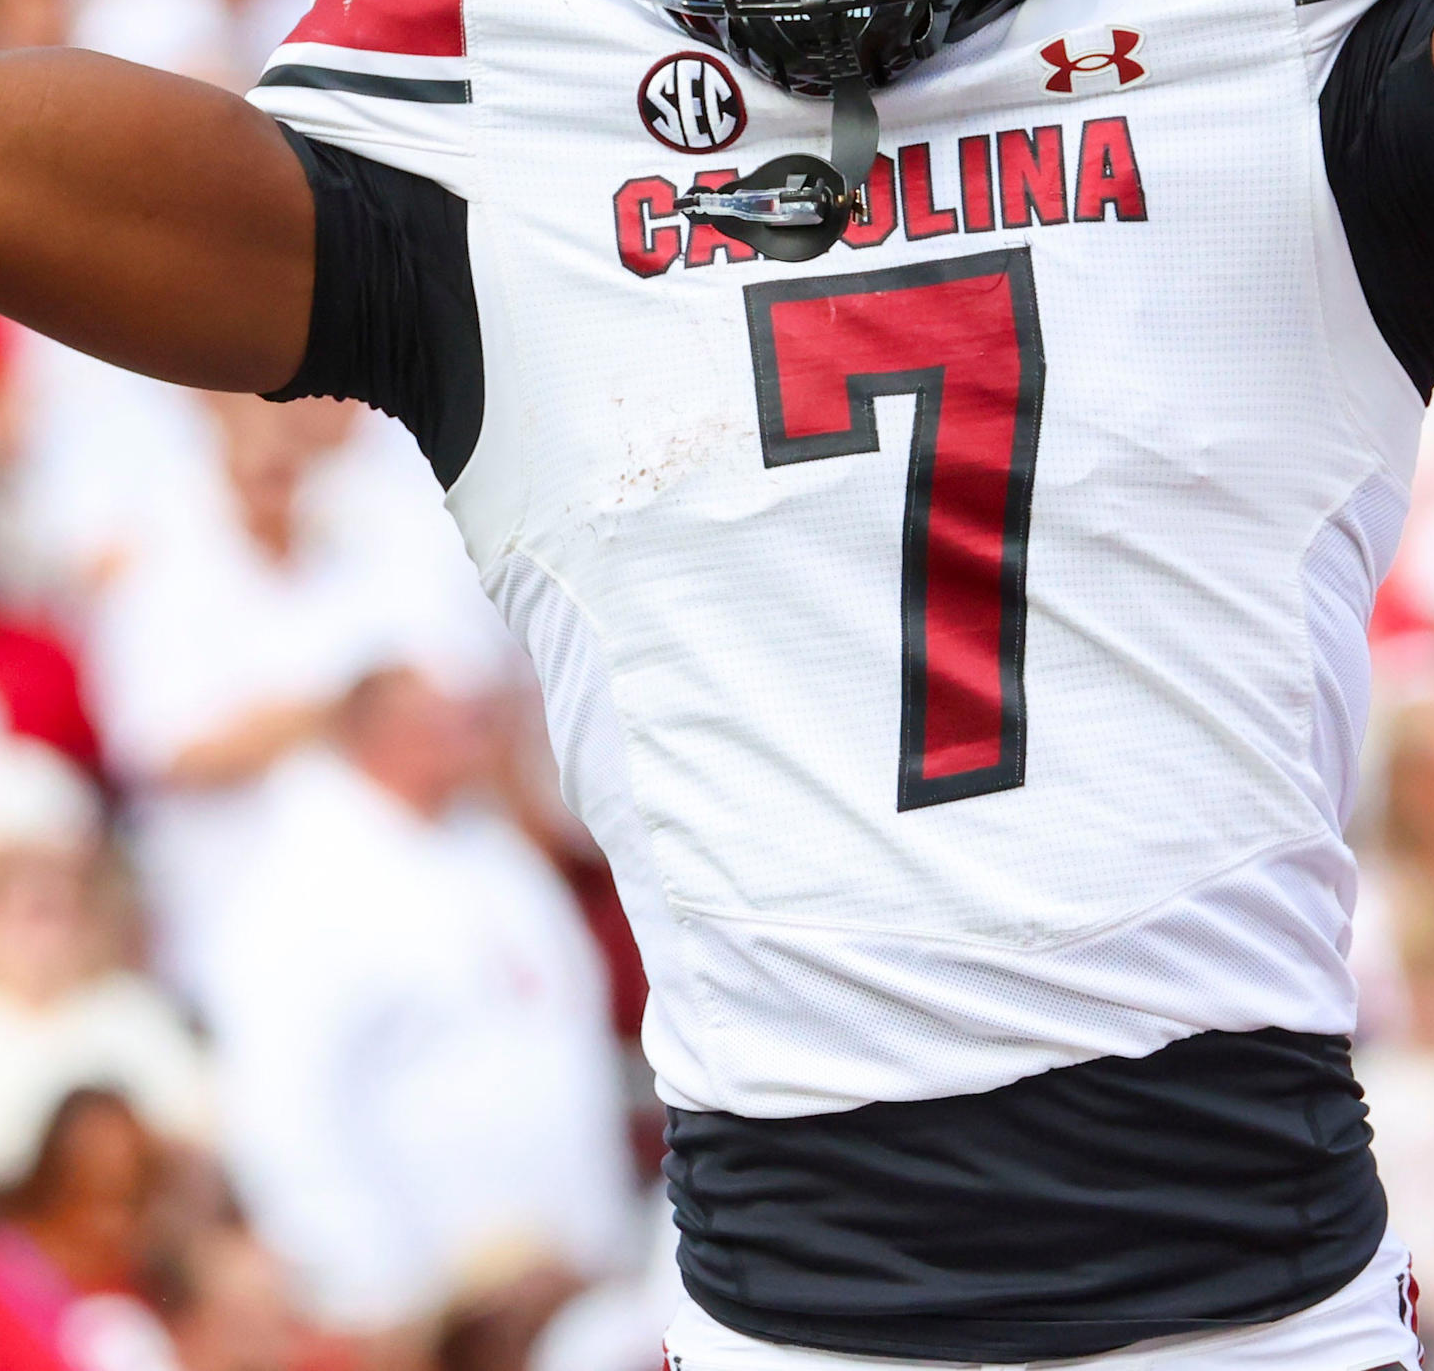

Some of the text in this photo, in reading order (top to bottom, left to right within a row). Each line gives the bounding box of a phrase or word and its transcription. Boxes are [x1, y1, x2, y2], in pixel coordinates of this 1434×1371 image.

[643, 56, 743, 150] SEC
[612, 115, 1149, 279] CAOLINA
[742, 245, 1046, 814] 7
